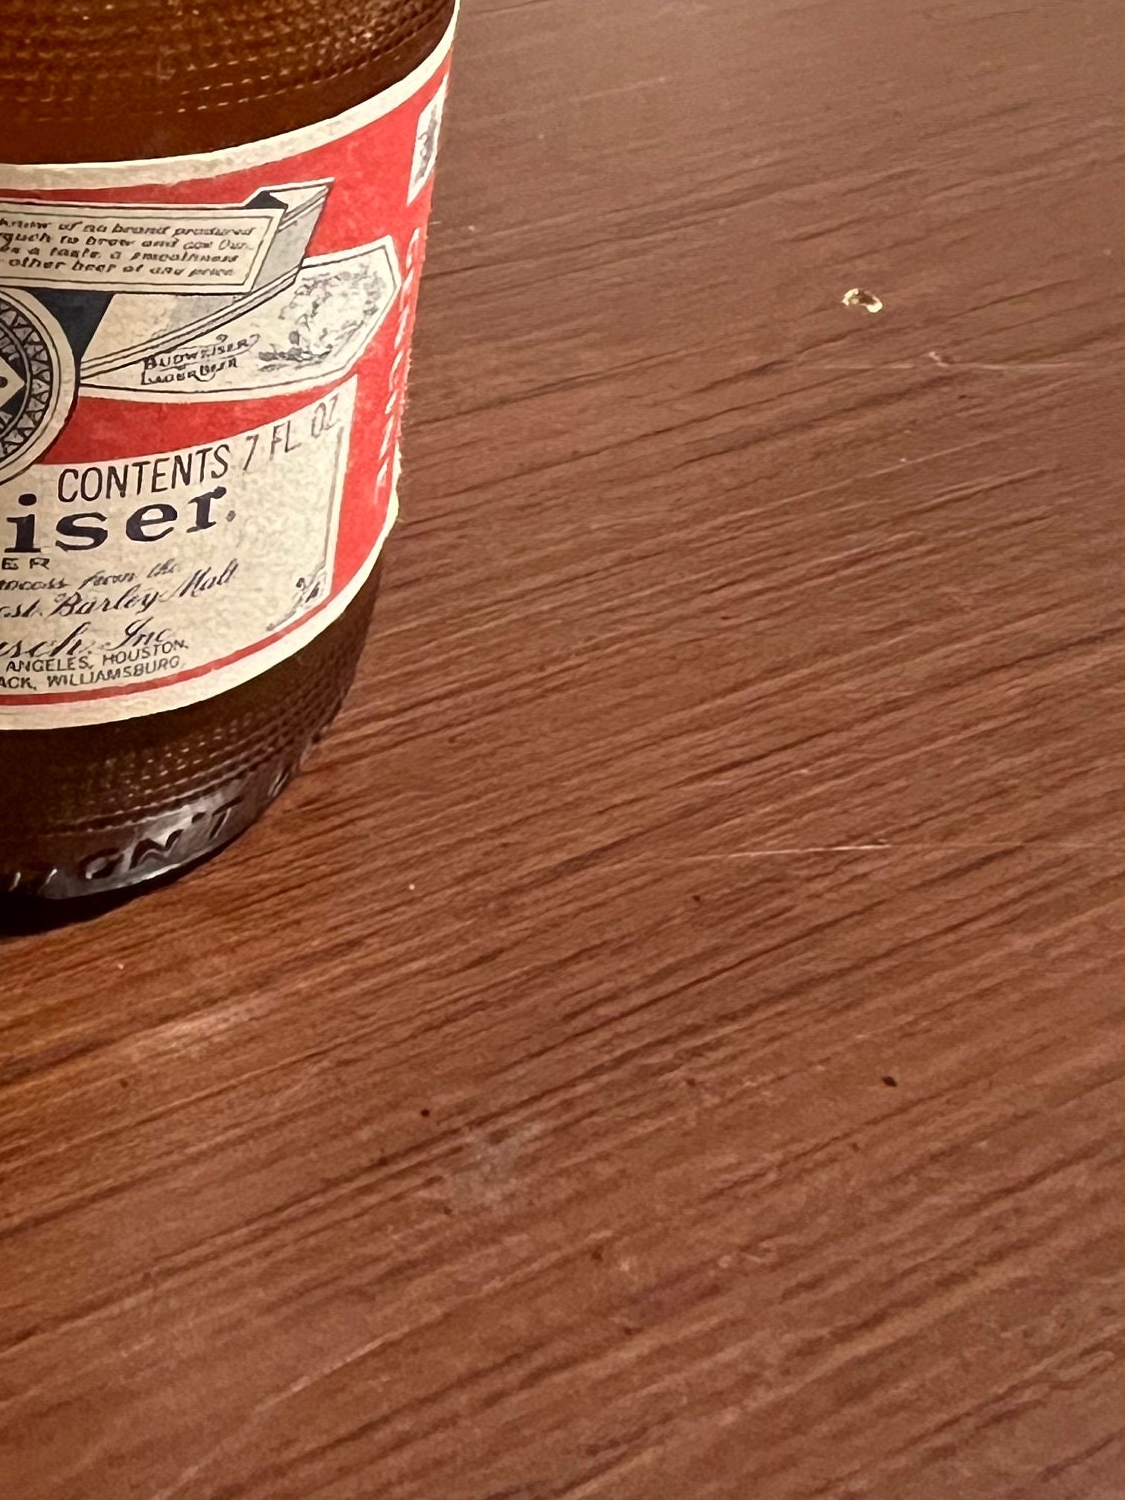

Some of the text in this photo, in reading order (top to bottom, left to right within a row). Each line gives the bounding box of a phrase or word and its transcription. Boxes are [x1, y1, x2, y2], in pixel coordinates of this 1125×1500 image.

[8, 257, 66, 271] other
[58, 443, 229, 503] CONTENTS
[243, 433, 259, 472] 7
